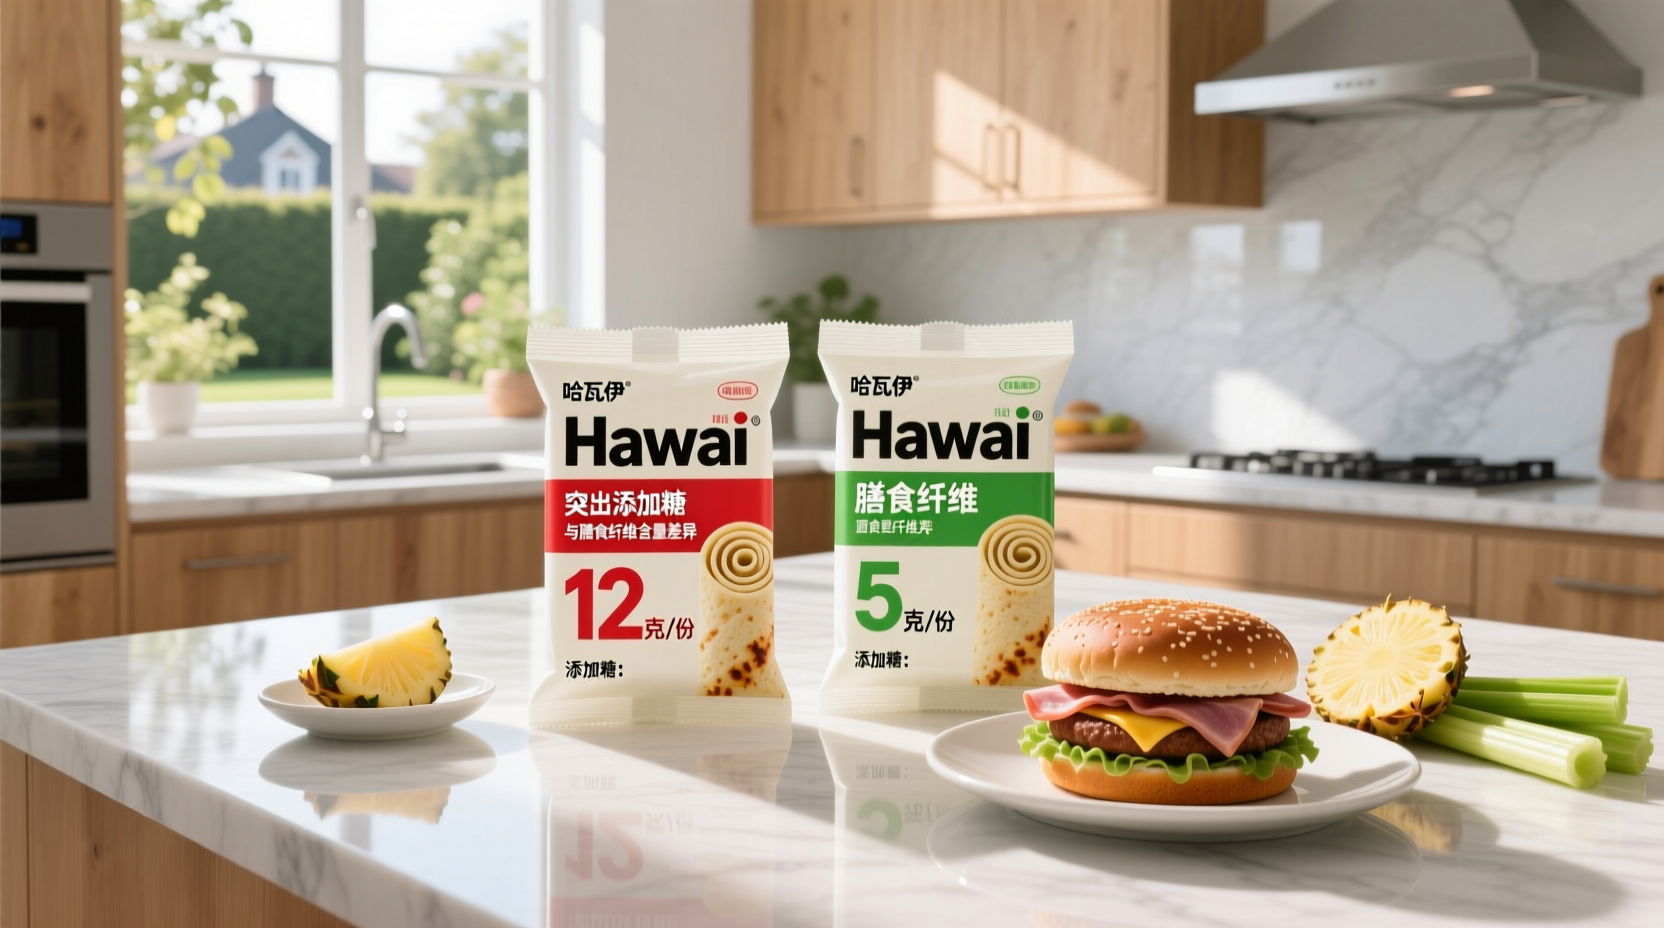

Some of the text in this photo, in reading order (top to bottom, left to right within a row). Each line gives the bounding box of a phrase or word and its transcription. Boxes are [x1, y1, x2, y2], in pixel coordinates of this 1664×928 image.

[562, 380, 626, 403] 哈瓦伊
[850, 375, 914, 398] 哈瓦伊
[565, 411, 748, 467] Hawai
[852, 406, 1030, 460] Hawai
[564, 489, 687, 517] 突出添加糖
[855, 480, 979, 514] 膳食纤维
